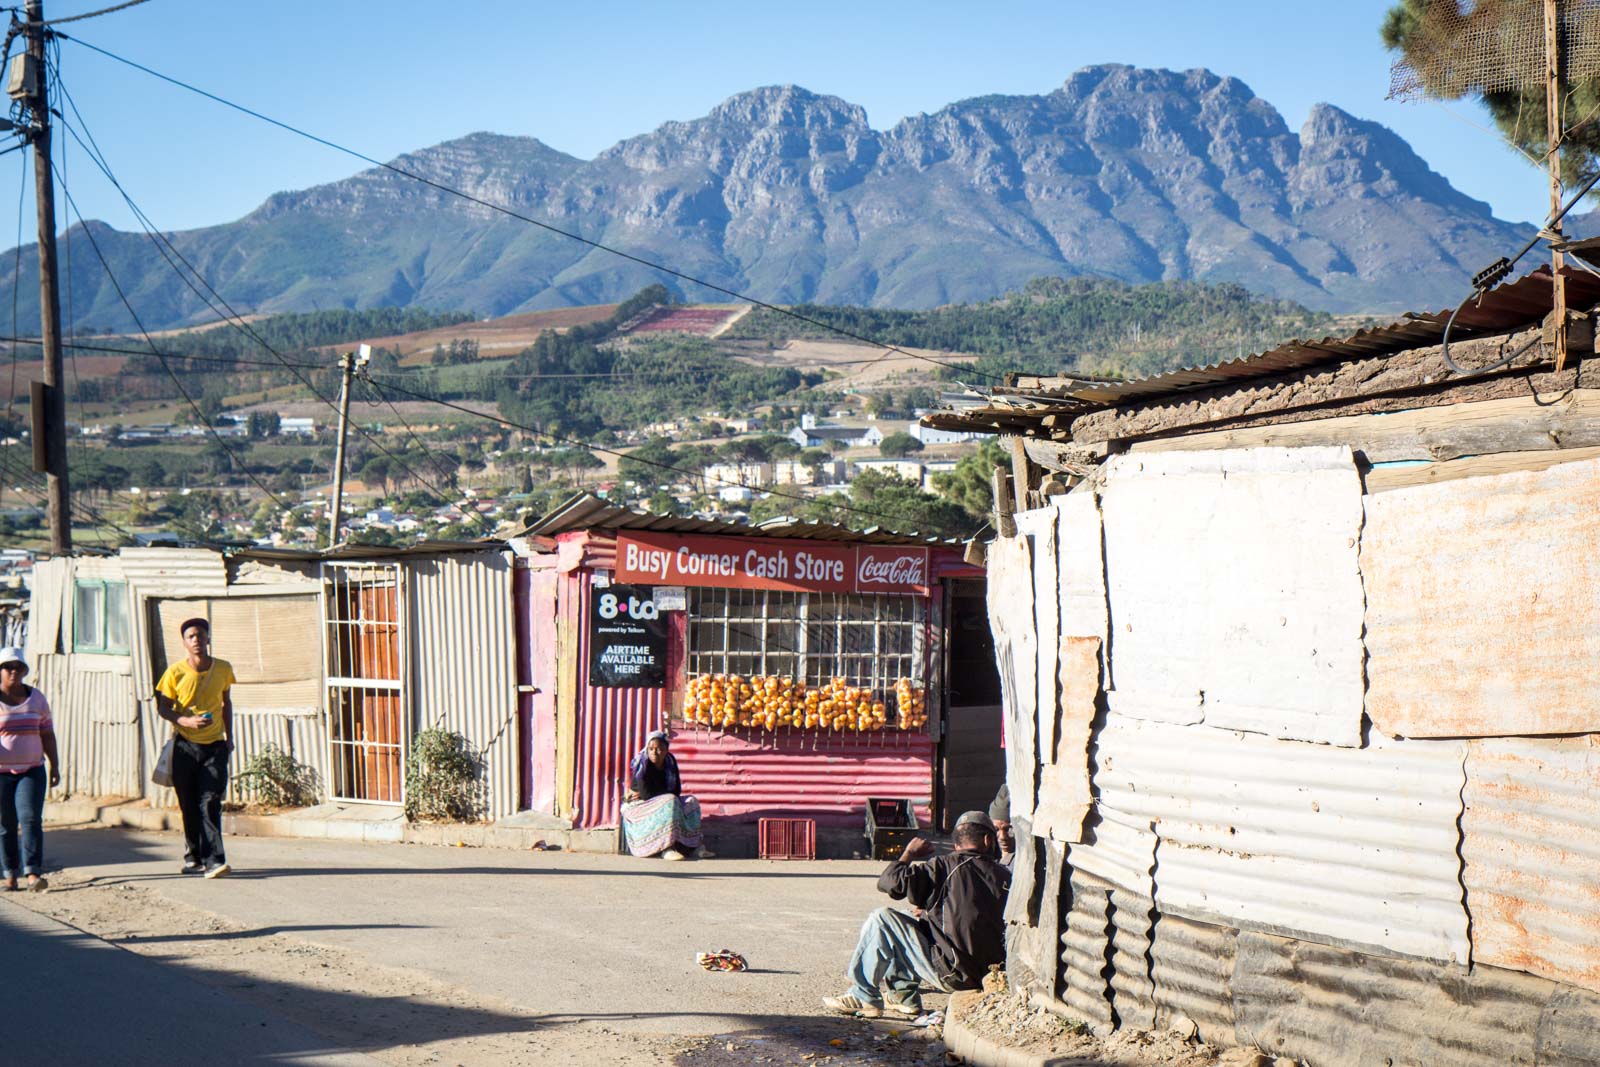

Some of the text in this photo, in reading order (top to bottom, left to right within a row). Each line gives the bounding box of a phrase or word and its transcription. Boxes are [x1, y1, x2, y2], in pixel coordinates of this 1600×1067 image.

[626, 543, 844, 581] Busy Corner Cash Store
[859, 555, 924, 584] Coca-Cola
[606, 645, 650, 655] AIRTIME
[601, 655, 655, 665] AVAILABLE
[614, 665, 641, 674] HERE
